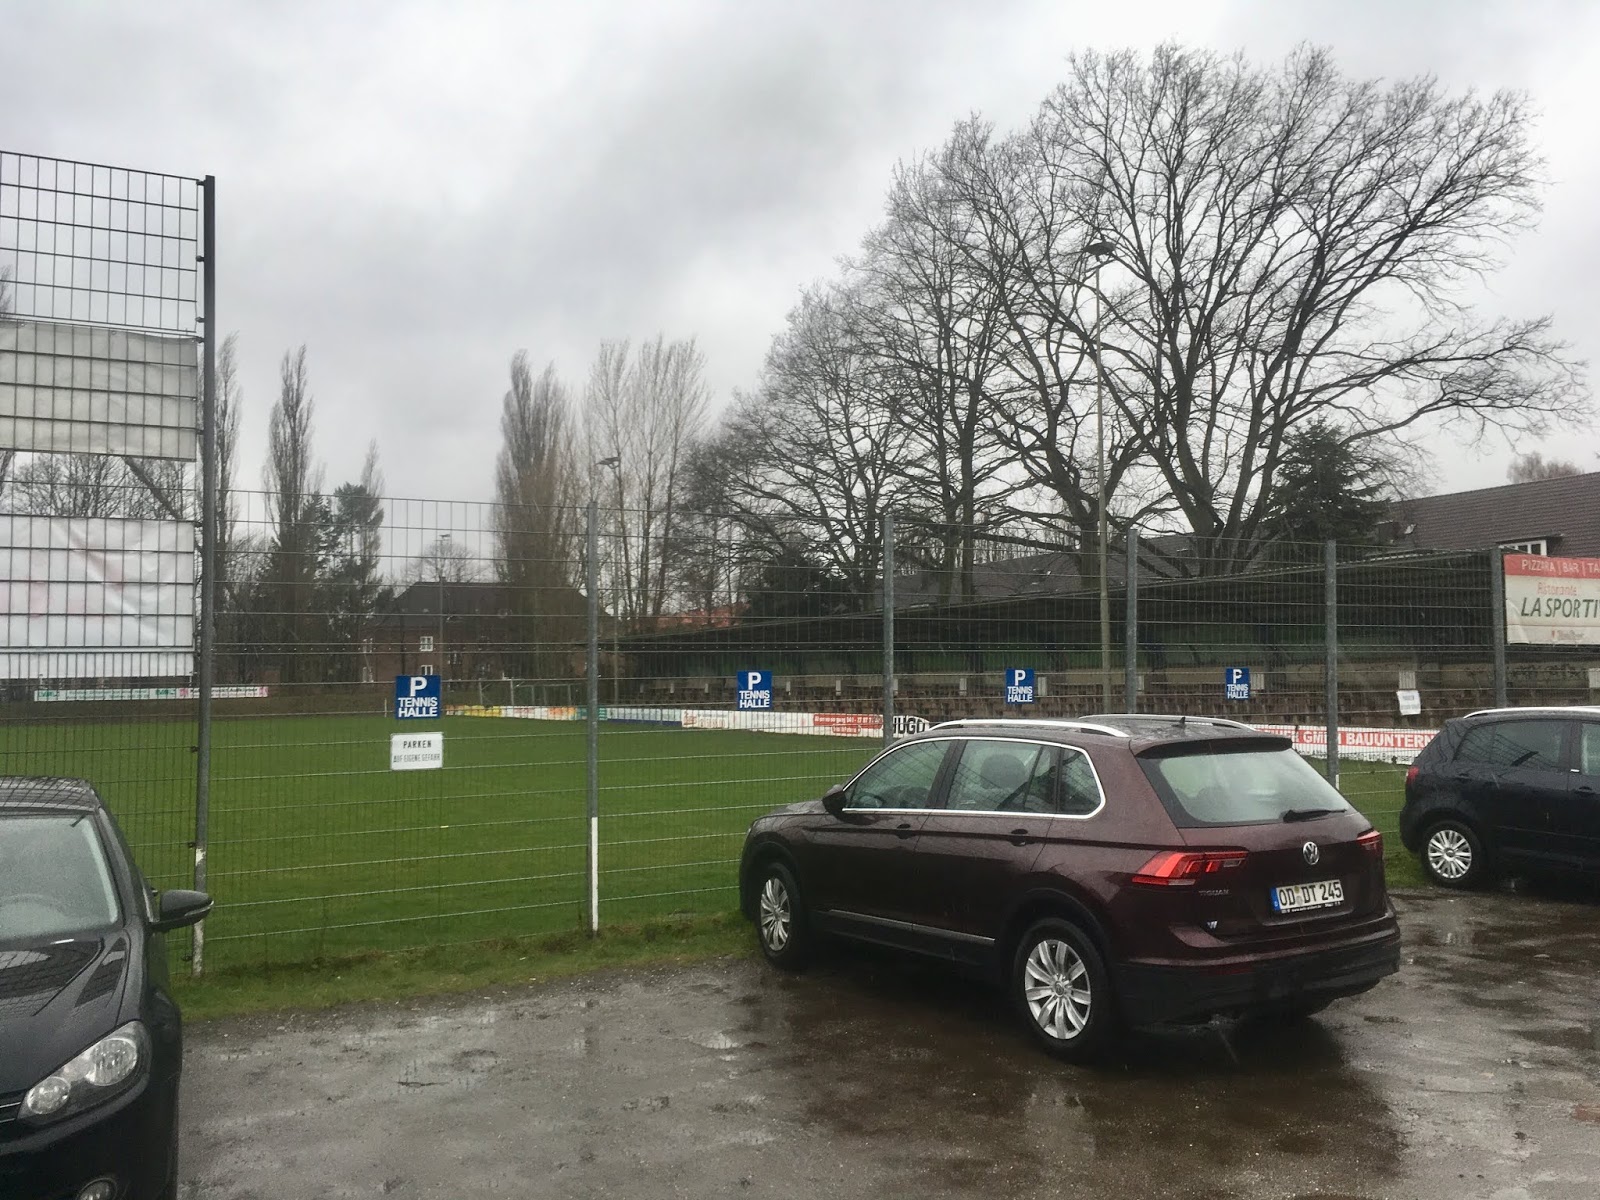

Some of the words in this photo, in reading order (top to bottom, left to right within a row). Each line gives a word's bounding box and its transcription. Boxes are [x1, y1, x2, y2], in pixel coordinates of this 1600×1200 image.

[1562, 562, 1579, 573] BAR
[1521, 597, 1541, 617] LA
[1545, 598, 1600, 619] SPORTI
[748, 672, 762, 690] P
[1015, 669, 1026, 686] P
[1233, 669, 1243, 684] P
[410, 677, 428, 697] P
[1007, 686, 1033, 695] TENNIS
[1227, 684, 1249, 692] TENNIS
[739, 690, 770, 700] TENNIS
[1007, 694, 1033, 703] HALLE
[1227, 691, 1249, 699] HALLE
[398, 697, 438, 708] TENNIS
[739, 699, 770, 708] HALLE
[398, 707, 438, 718] HALLE
[403, 740, 432, 749] PARKEN
[1278, 887, 1296, 906] OD
[1301, 885, 1317, 904] DT
[1319, 882, 1342, 901] 245
